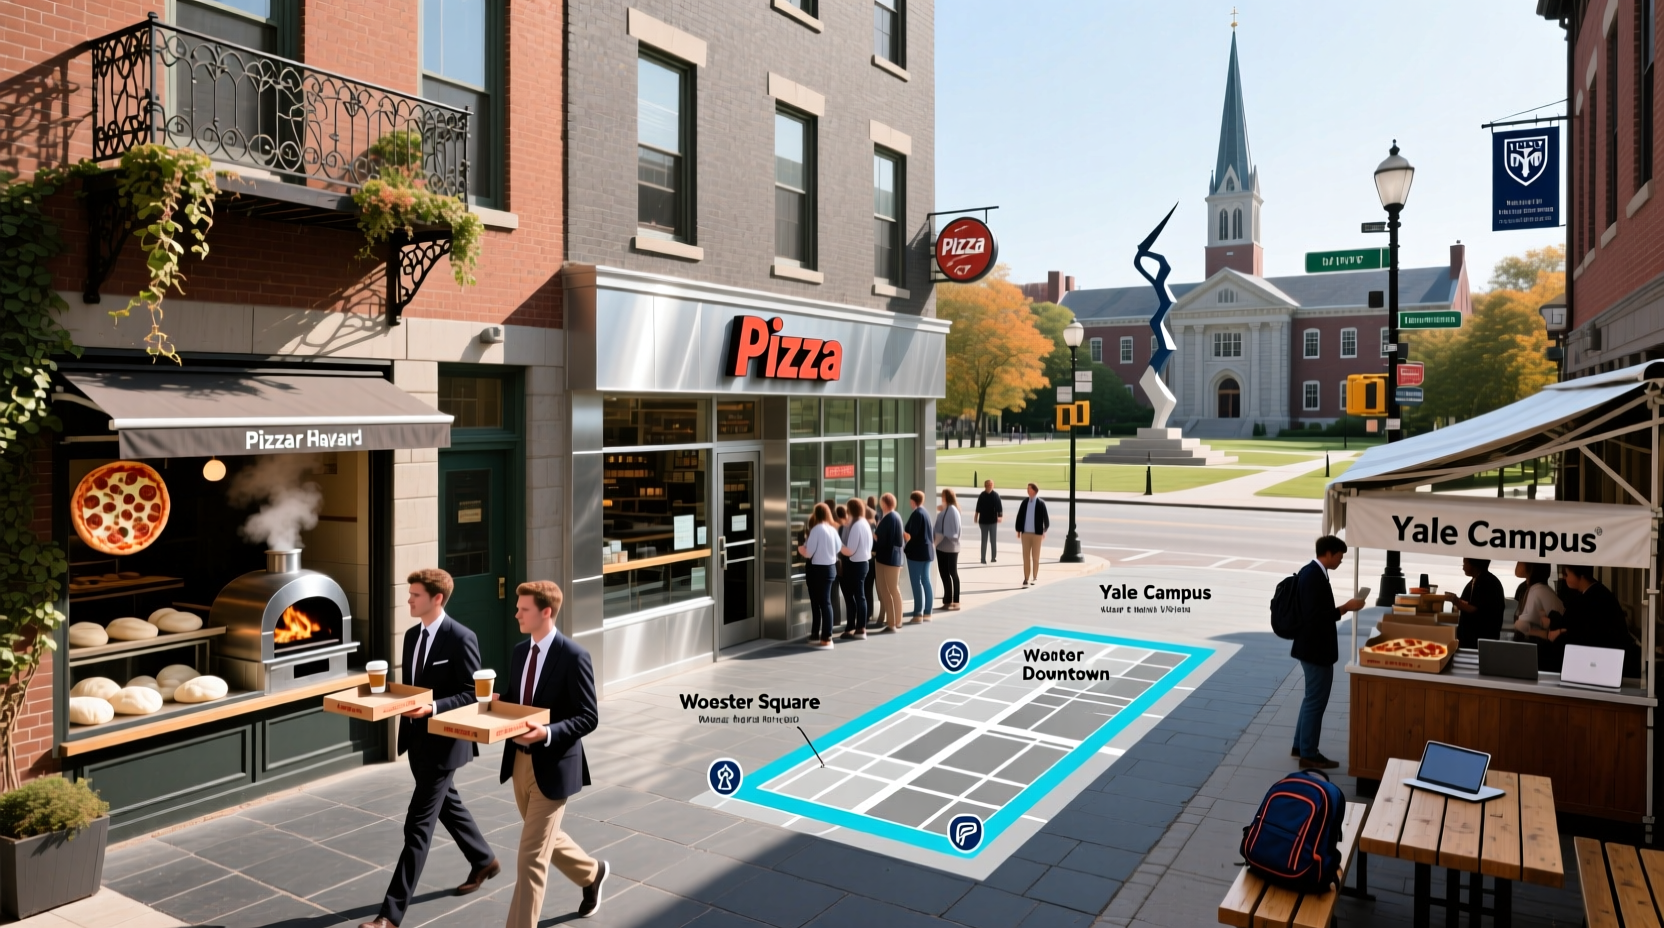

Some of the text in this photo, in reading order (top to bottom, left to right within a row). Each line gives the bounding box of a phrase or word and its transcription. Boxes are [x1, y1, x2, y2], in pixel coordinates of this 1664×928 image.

[733, 315, 842, 381] Pizza
[246, 430, 304, 449] Pizzar
[1392, 515, 1458, 545] Yale
